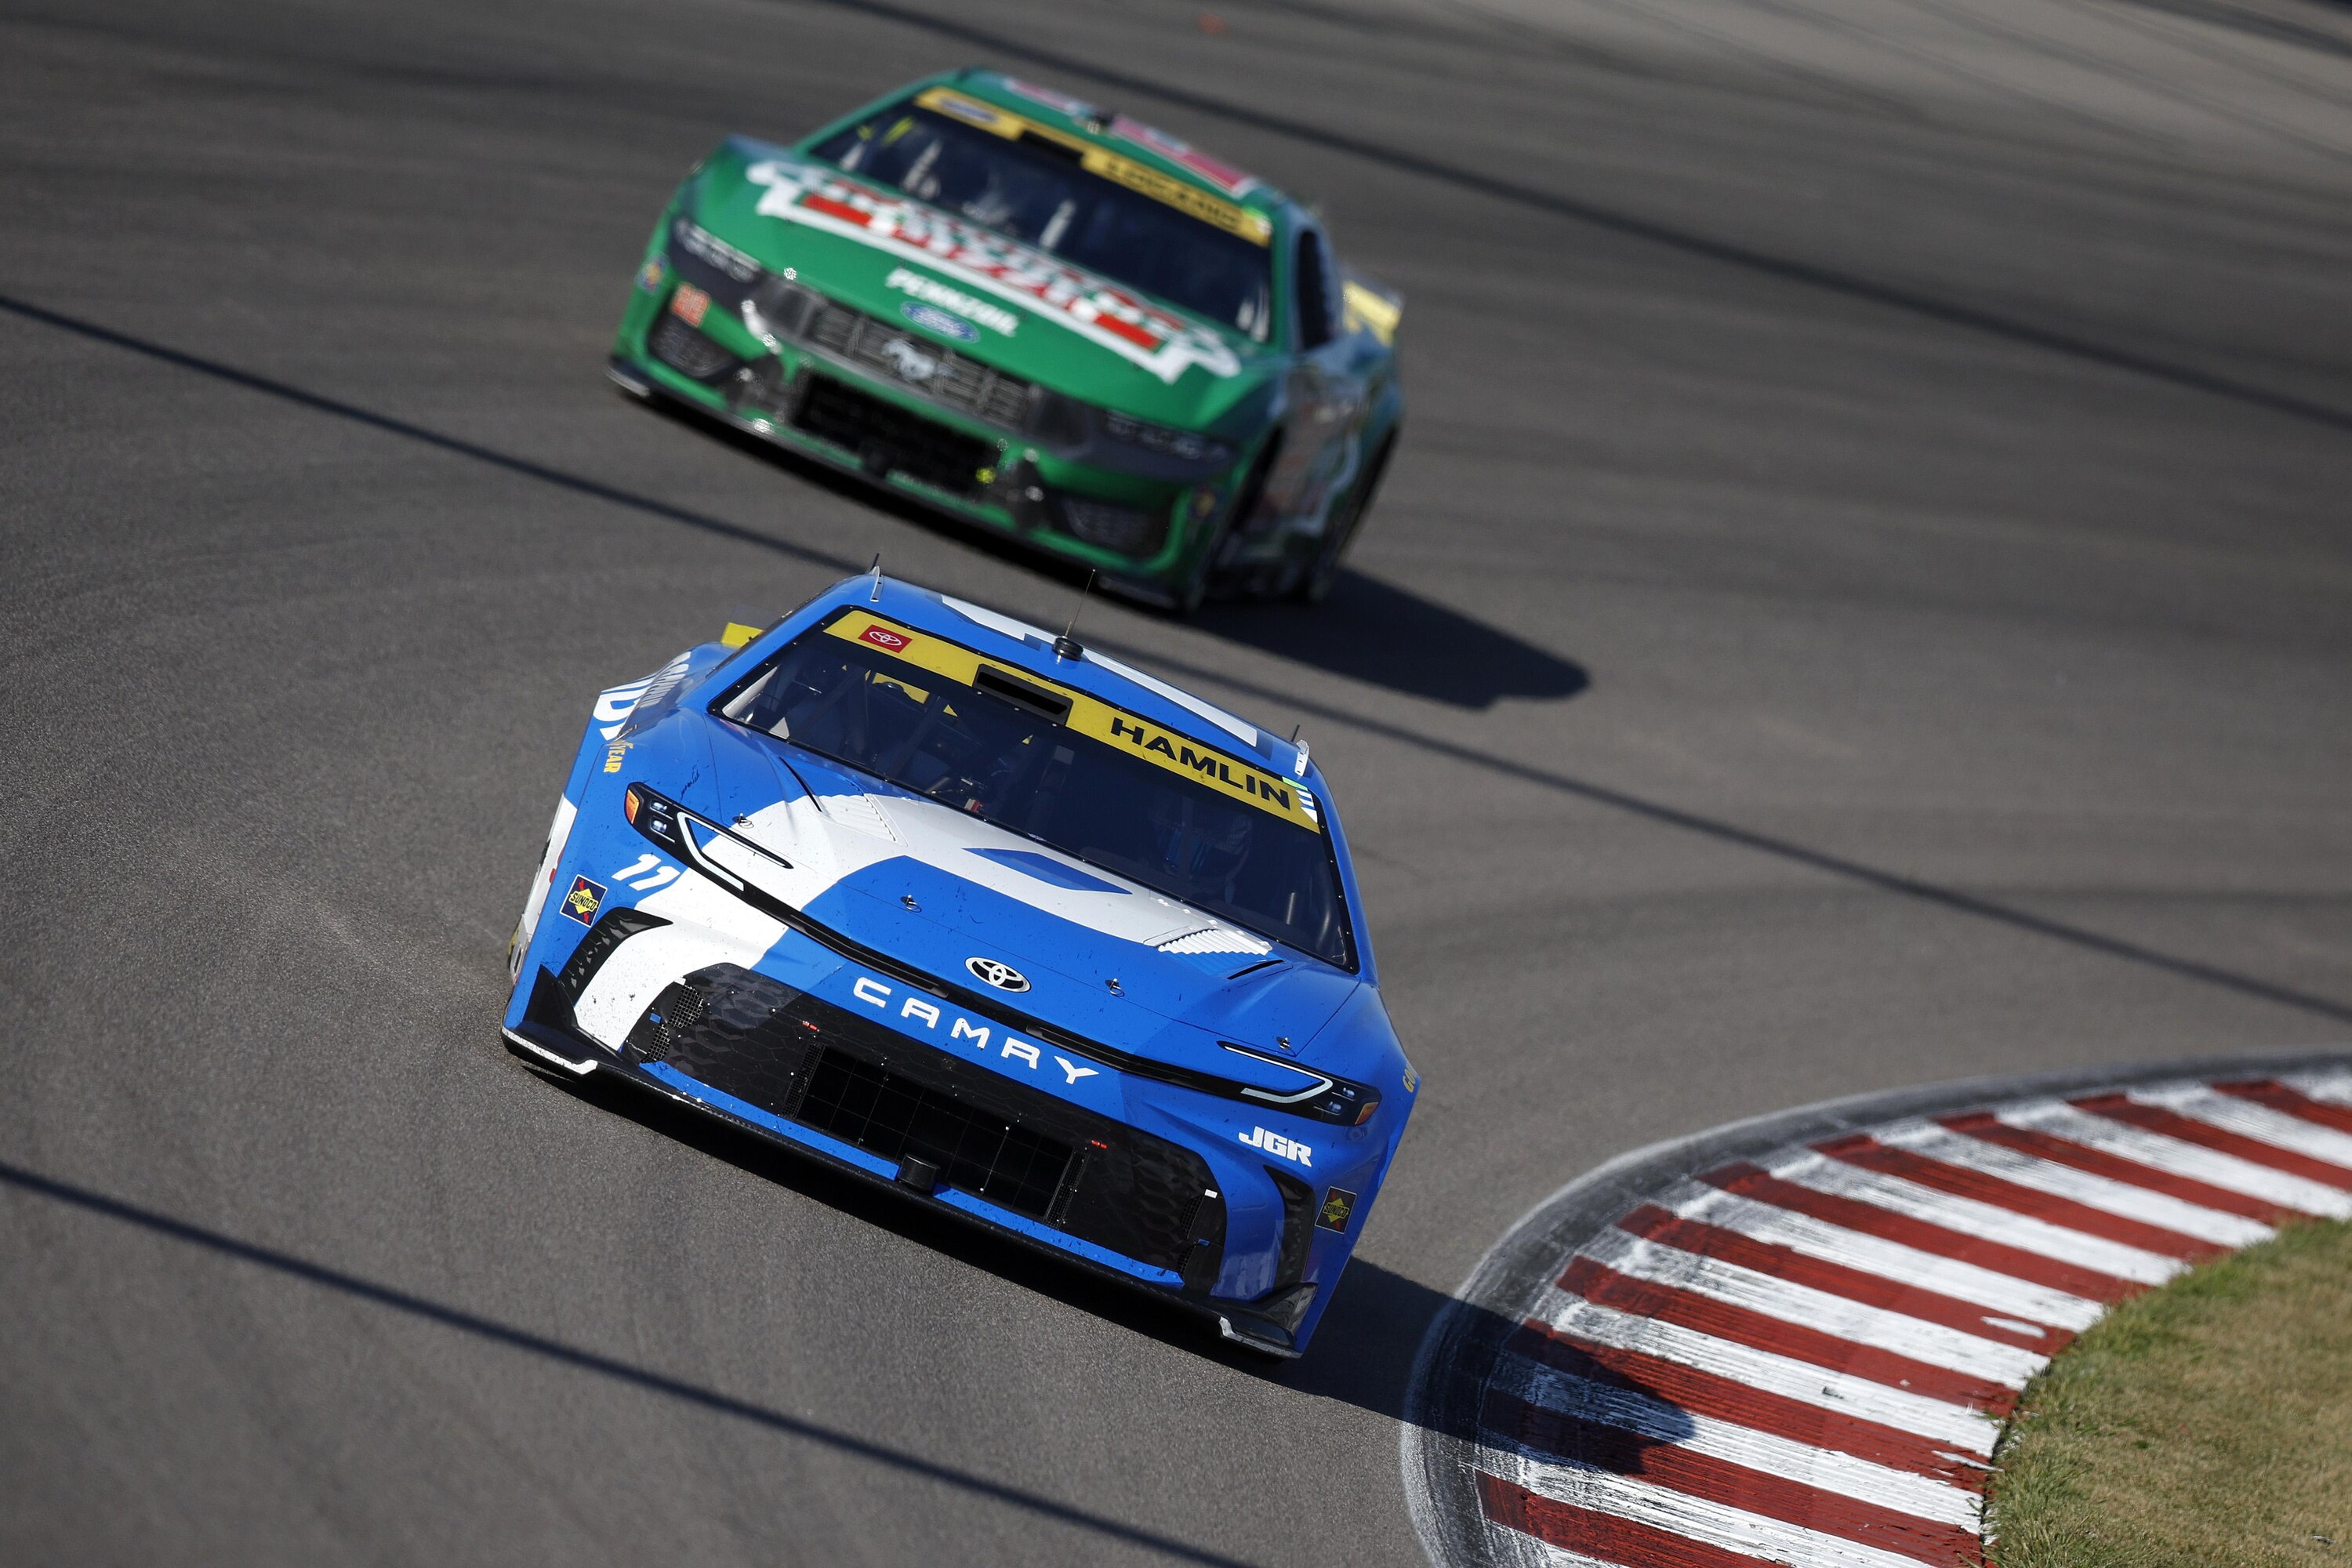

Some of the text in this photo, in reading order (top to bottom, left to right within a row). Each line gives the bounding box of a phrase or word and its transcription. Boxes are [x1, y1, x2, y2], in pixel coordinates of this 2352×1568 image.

[1110, 717, 1290, 811] HAMLIN
[611, 853, 681, 891] 11
[569, 891, 597, 911] SUNOCO
[853, 977, 1099, 1085] CAMRY
[1238, 1125, 1312, 1167] JGR
[1323, 1203, 1349, 1218] SUNOCO
